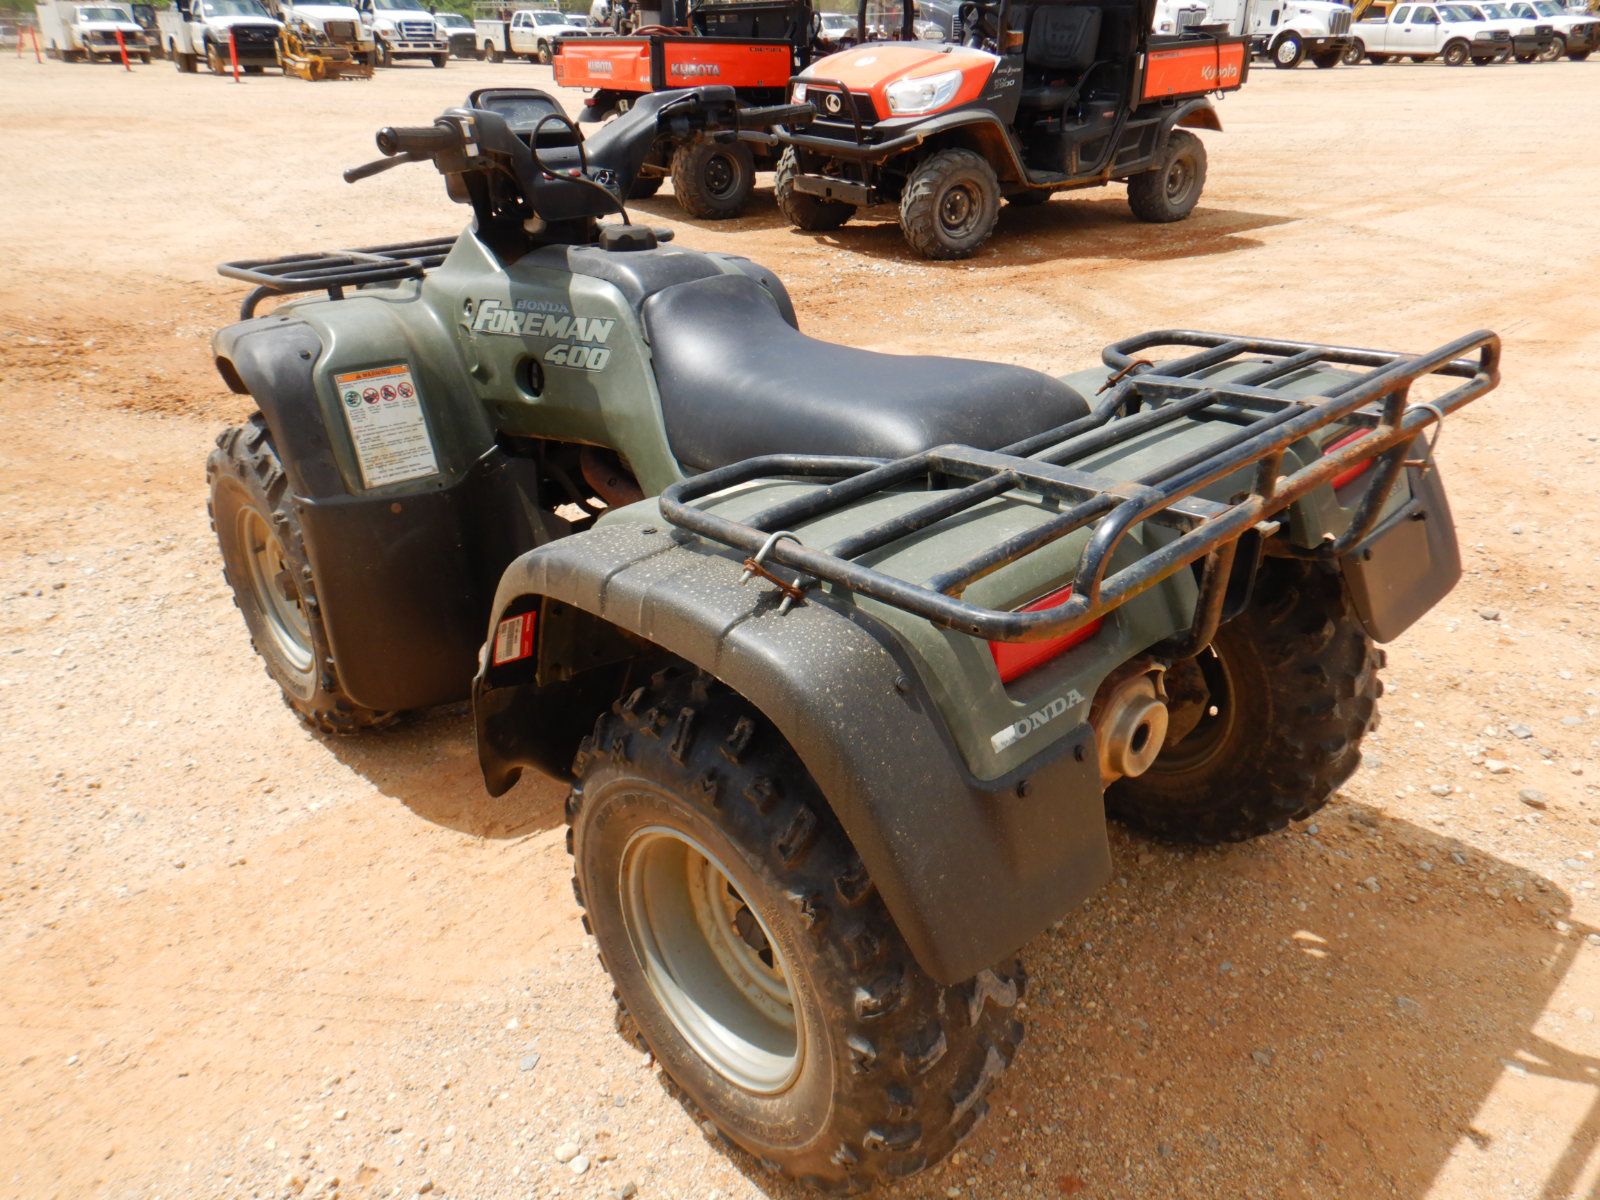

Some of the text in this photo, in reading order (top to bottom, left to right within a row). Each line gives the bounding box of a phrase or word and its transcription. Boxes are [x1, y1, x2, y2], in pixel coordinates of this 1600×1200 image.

[587, 60, 613, 74] KUBOTA
[671, 62, 721, 77] KUBOTA
[516, 299, 569, 314] HONDA
[472, 299, 616, 344] FOREMAN
[543, 343, 612, 371] 400
